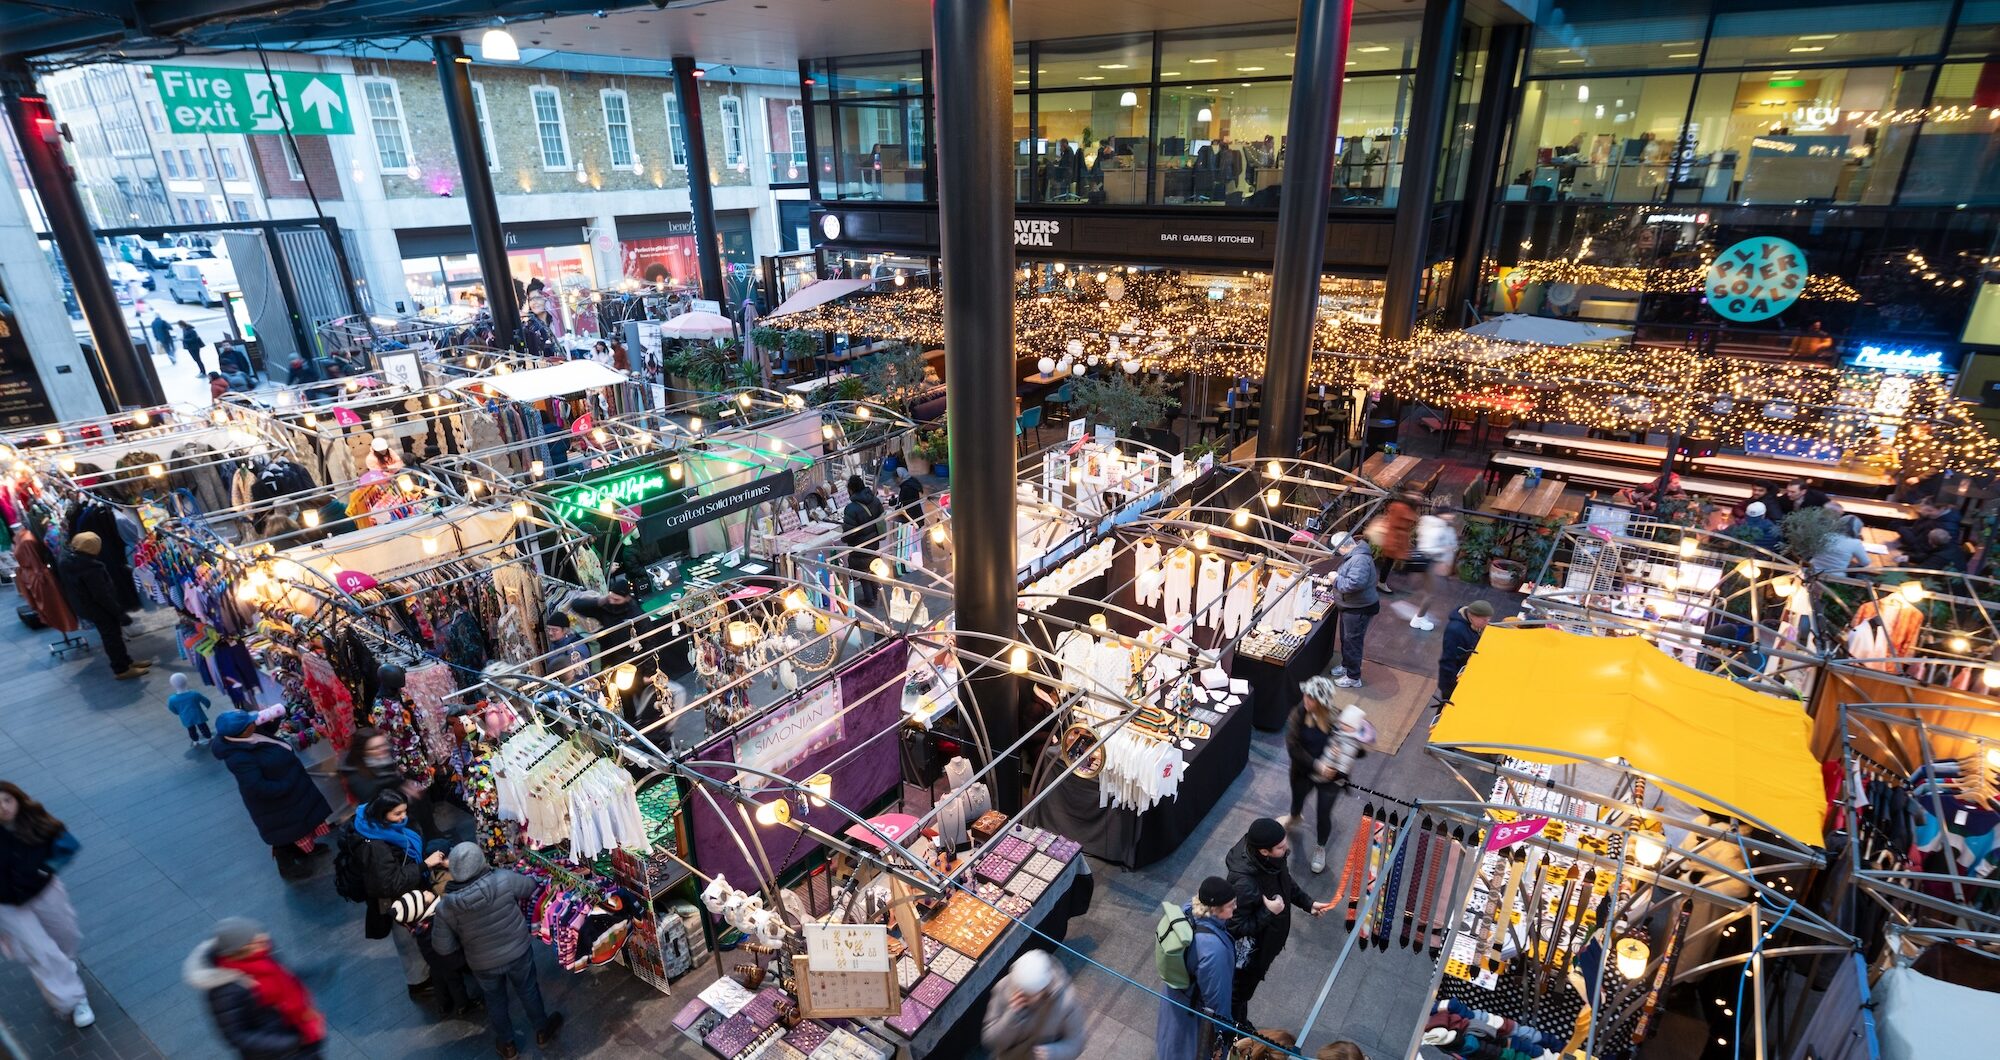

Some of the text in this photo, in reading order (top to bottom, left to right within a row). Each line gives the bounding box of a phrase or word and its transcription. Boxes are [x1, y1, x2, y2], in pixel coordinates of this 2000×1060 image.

[161, 70, 233, 99] Fire
[174, 101, 240, 127] exit
[1014, 219, 1060, 234] AYERS
[1160, 233, 1255, 244] BAR GAMES KITCHEN
[666, 484, 771, 527] Crafted Solid Perfumes
[346, 576, 361, 587] 10
[755, 704, 823, 755] SIMONIAN
[1496, 827, 1513, 840] CP
[1513, 825, 1531, 835] 21
